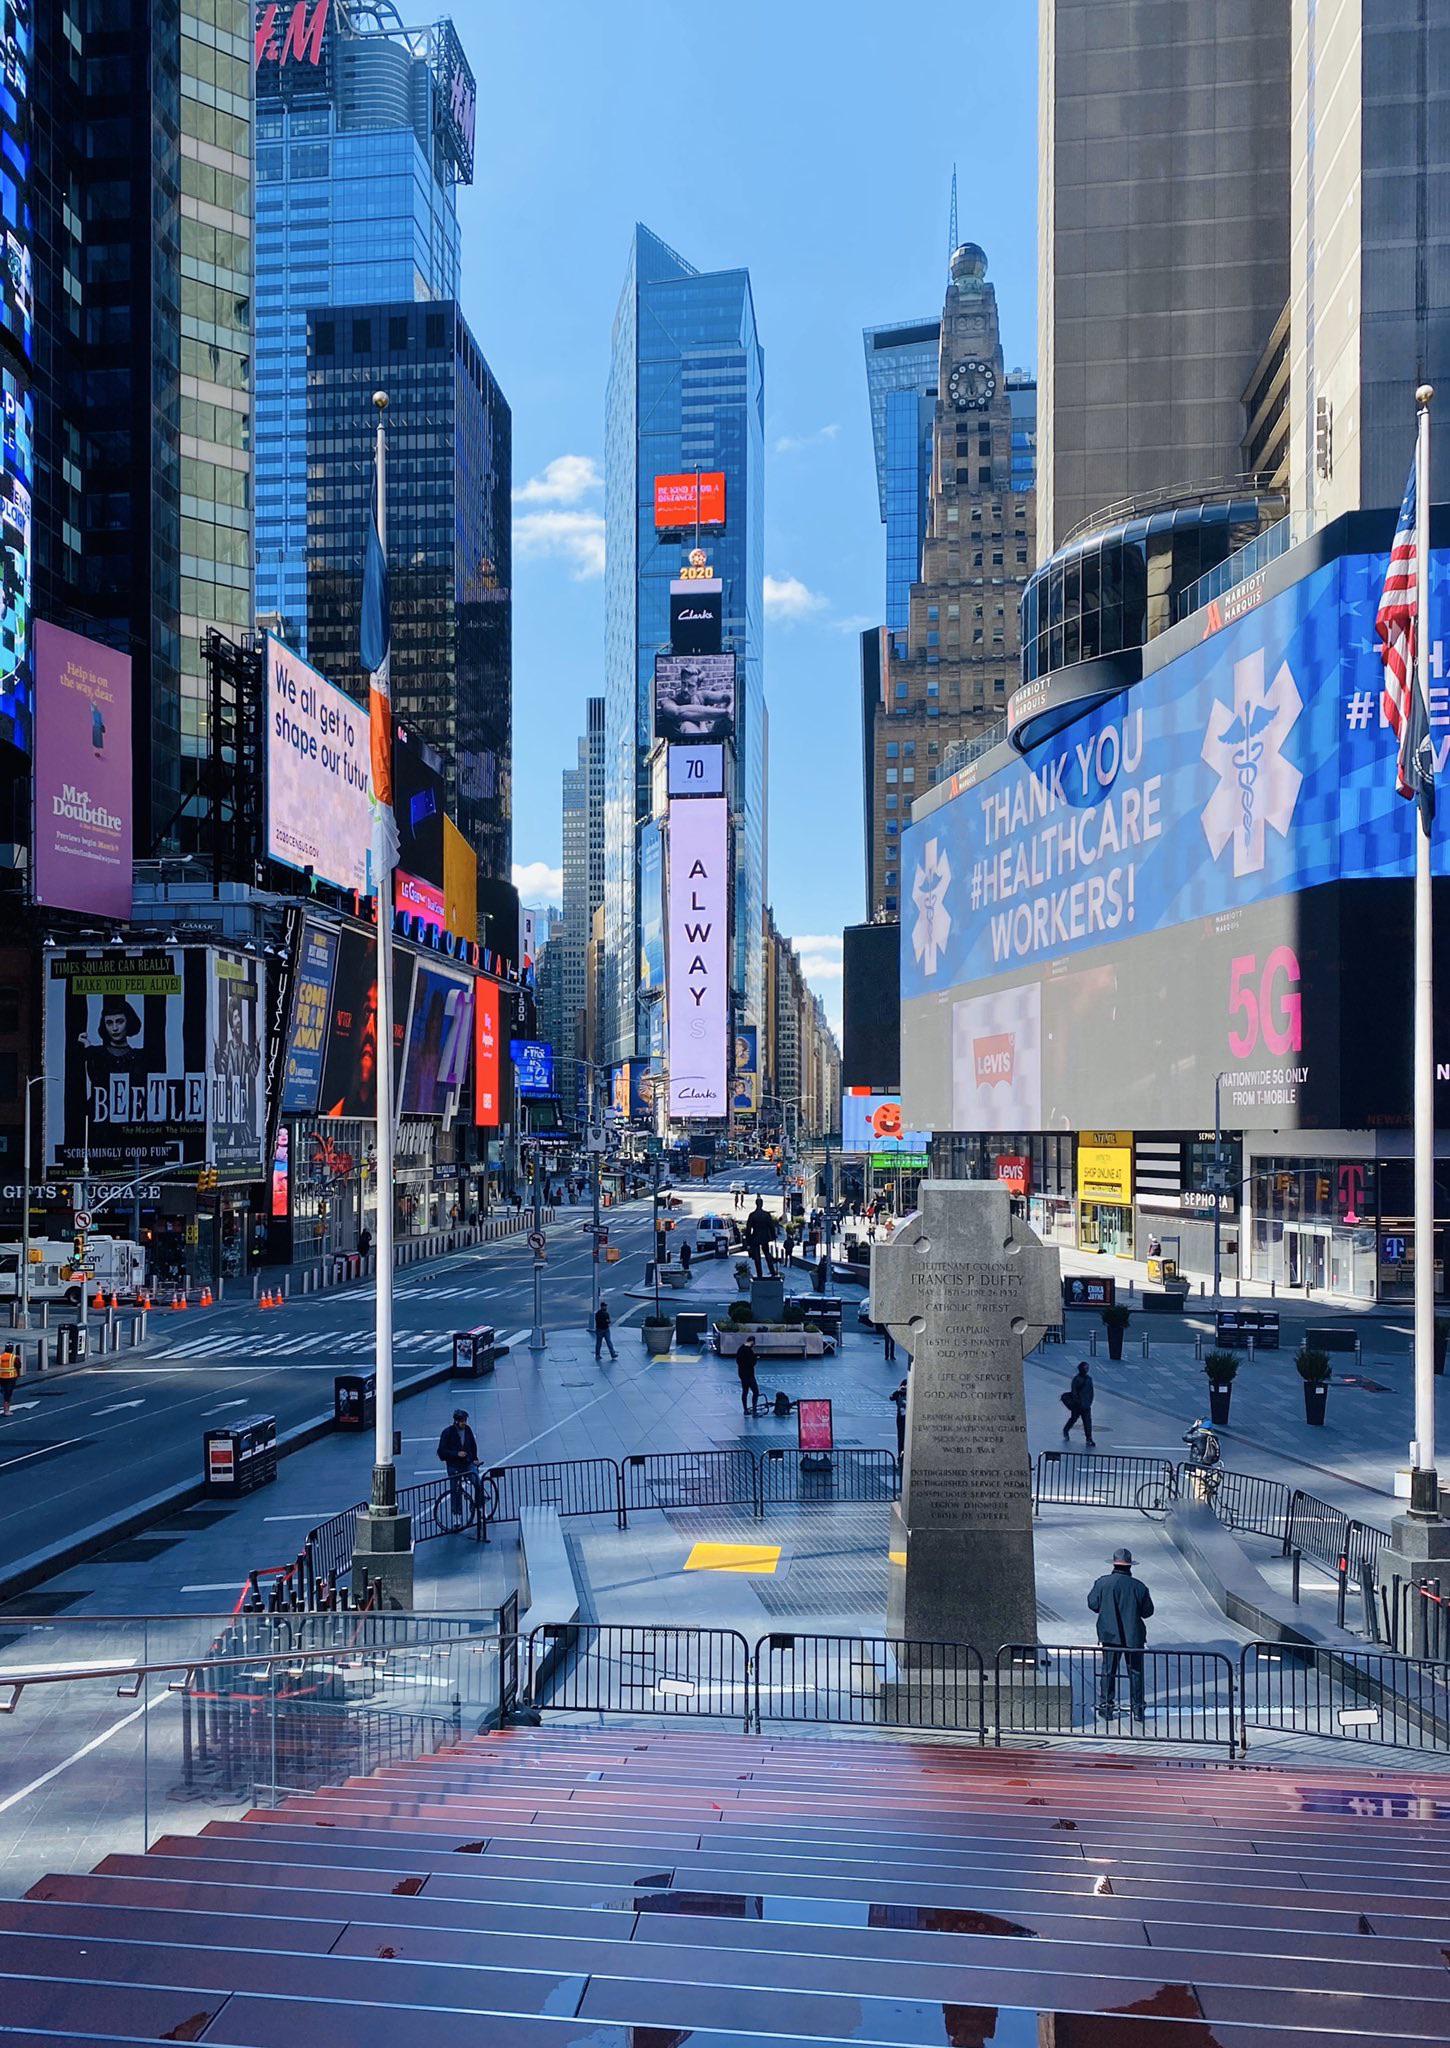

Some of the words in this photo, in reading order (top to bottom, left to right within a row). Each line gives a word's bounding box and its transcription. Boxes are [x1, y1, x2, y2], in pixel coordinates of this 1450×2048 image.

[680, 567, 713, 579] 2020
[1225, 571, 1267, 607] MARRIOTT
[678, 609, 714, 620] Clarks
[1224, 590, 1262, 622] MARQUIS
[60, 674, 74, 688] the
[67, 661, 88, 682] Help
[97, 676, 108, 688] on
[1015, 676, 1052, 706] MARRIOTT
[275, 661, 297, 704] We
[301, 686, 316, 720] all
[320, 703, 339, 736] get
[343, 713, 355, 748] to
[1015, 693, 1046, 720] MARQUIS
[275, 708, 317, 760] shape
[321, 744, 340, 775] our
[686, 759, 704, 779] 70
[981, 752, 1068, 846] THANK
[1076, 707, 1143, 797] YOU
[62, 783, 91, 804] Mrs.
[53, 795, 122, 831] Doubtfire
[971, 774, 1162, 911] #HEALTHCARE
[991, 863, 1135, 963] WORKERS!
[54, 961, 80, 975] TIMES
[82, 960, 115, 974] SQUARE
[118, 959, 135, 972] CAN
[138, 957, 171, 971] REALLY
[76, 979, 101, 991] MAKE
[104, 978, 122, 991] YOU
[125, 978, 144, 991] FEEL
[149, 978, 179, 991] ALIVE!
[273, 973, 288, 1031] MAC
[299, 982, 327, 1007] COME
[1228, 945, 1303, 1059] 5G
[292, 1026, 322, 1051] AWAY
[265, 1037, 280, 1095] MAC
[1222, 1069, 1271, 1087] NATIONWIDE
[1272, 1069, 1284, 1085] 5G
[1285, 1067, 1309, 1083] ONLY
[93, 1073, 205, 1123] BEETLE
[678, 1087, 717, 1099] Clarks
[1232, 1090, 1256, 1106] FROM
[1257, 1088, 1296, 1105] T-MOBILE
[125, 1147, 147, 1158] GOOD
[918, 1262, 970, 1271] LIEUTENANT
[973, 1262, 1016, 1271] COLONEL
[911, 1274, 963, 1285] FRANCIS
[980, 1275, 1024, 1286] DUFFY
[926, 1304, 972, 1312] CATHOLIC
[976, 1304, 1009, 1312] PRIEST
[946, 1326, 990, 1334] CHAPLAIN
[937, 1350, 956, 1358] OLD
[974, 1373, 1011, 1381] SERVICE
[924, 1391, 945, 1399] GOD
[948, 1391, 967, 1399] AND
[971, 1391, 1015, 1400] COUNTRY
[999, 1425, 1026, 1433] GUARD
[943, 1446, 972, 1454] WORLD
[911, 1469, 967, 1477] DISTINGUISHED
[970, 1469, 1000, 1477] SERVICE
[911, 1480, 968, 1488] DISTINGUISHED
[970, 1480, 1000, 1488] SERVICE
[970, 1491, 1000, 1499] SERVICE
[1003, 1491, 1029, 1499] CROSS
